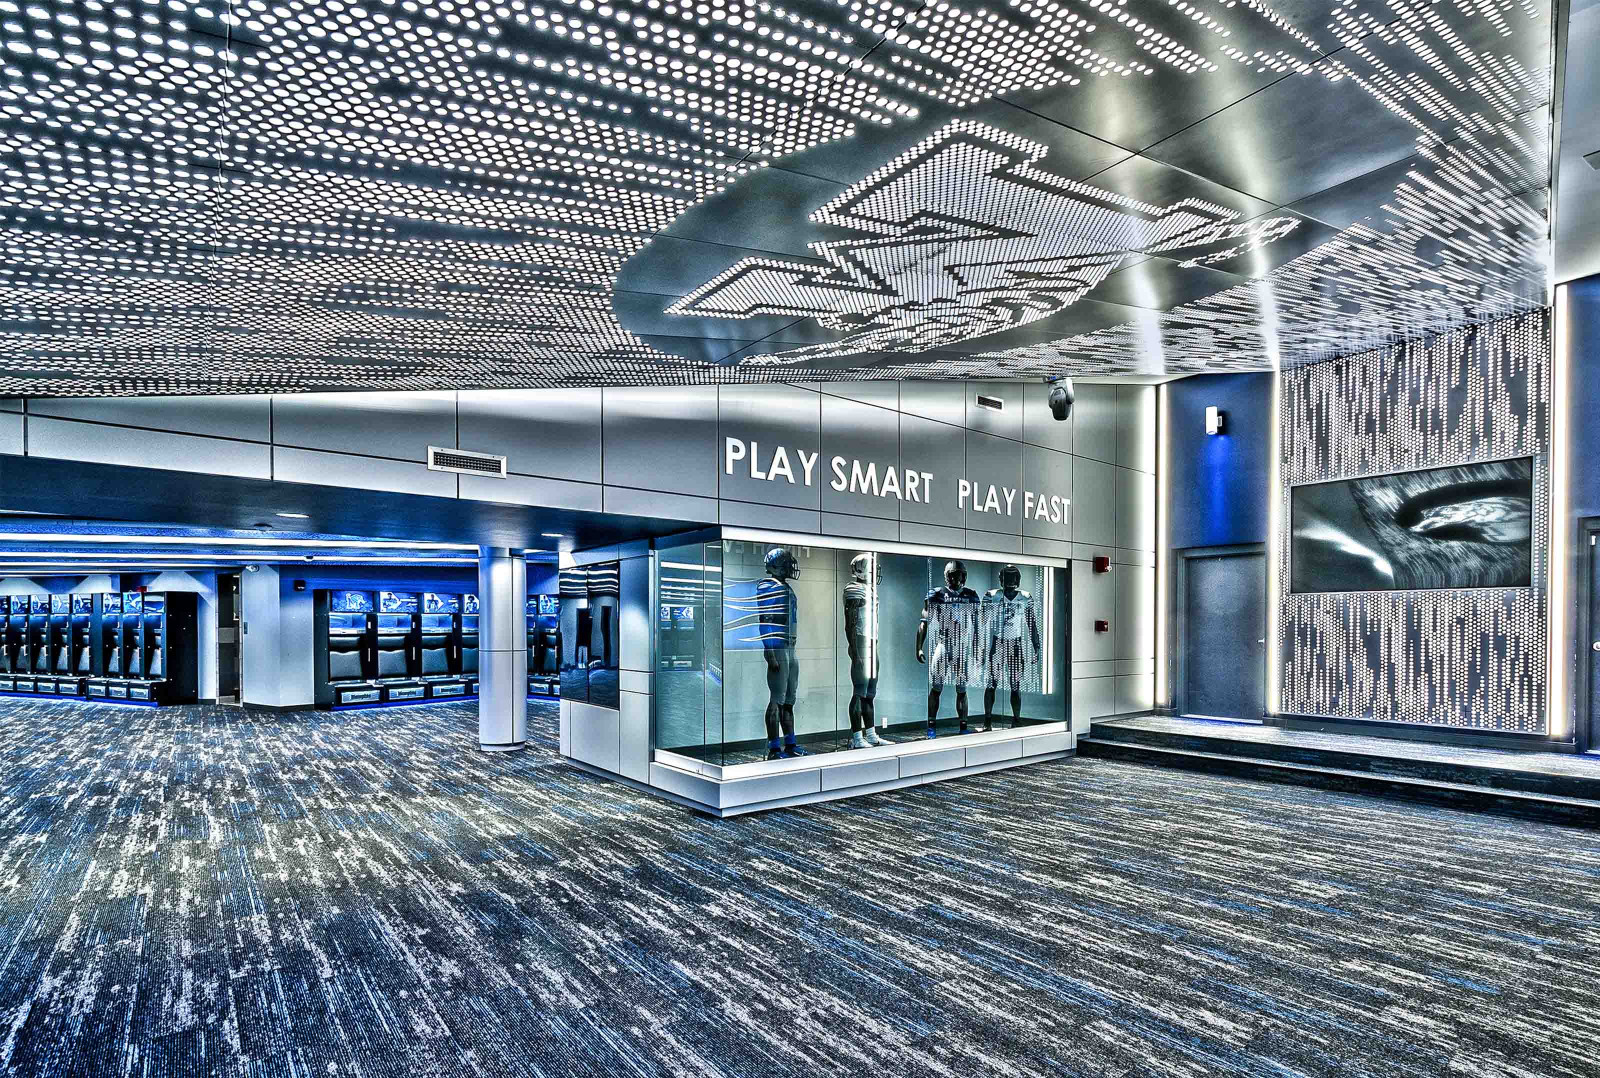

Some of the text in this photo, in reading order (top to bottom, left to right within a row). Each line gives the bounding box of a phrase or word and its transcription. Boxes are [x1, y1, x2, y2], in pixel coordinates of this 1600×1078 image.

[725, 437, 1071, 525] PLAY SMART PLAY FAST
